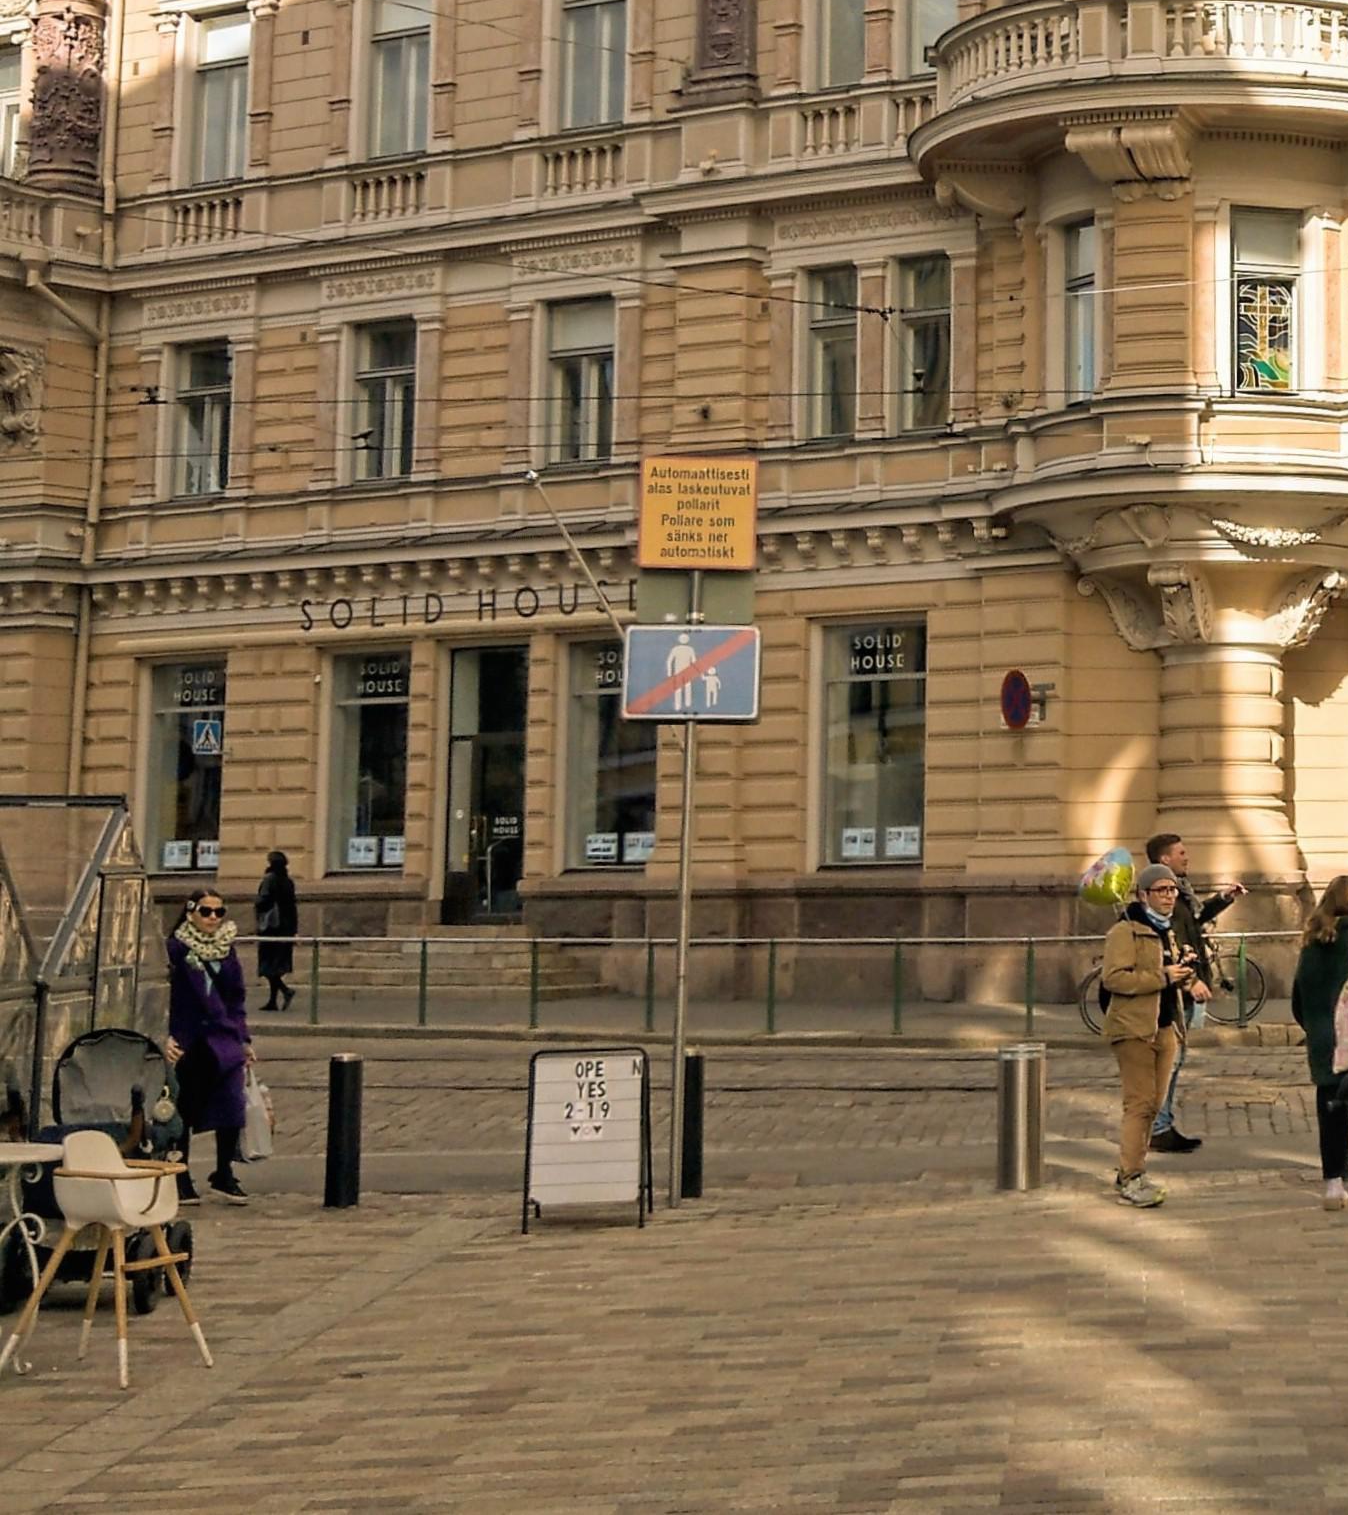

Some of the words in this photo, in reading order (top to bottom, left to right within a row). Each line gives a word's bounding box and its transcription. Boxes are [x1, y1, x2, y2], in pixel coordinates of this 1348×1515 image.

[650, 466, 750, 481] Automaattisesti
[647, 483, 672, 494] alas
[678, 483, 751, 496] laskeutuvat
[677, 498, 720, 511] pollarit
[661, 513, 703, 527] Pollare
[709, 516, 735, 527] som
[666, 530, 703, 542] sänks
[708, 533, 728, 543] ner
[660, 546, 735, 558] automatiskt
[300, 592, 444, 631] SOLID
[853, 633, 903, 650] SOLID
[360, 661, 401, 675] SOLID
[850, 653, 904, 670] HOUSE
[177, 670, 216, 685] SOLID
[356, 679, 402, 693] HOUSE
[173, 688, 217, 702] HOUSE
[575, 1061, 604, 1078] OPE
[577, 1081, 607, 1099] YES
